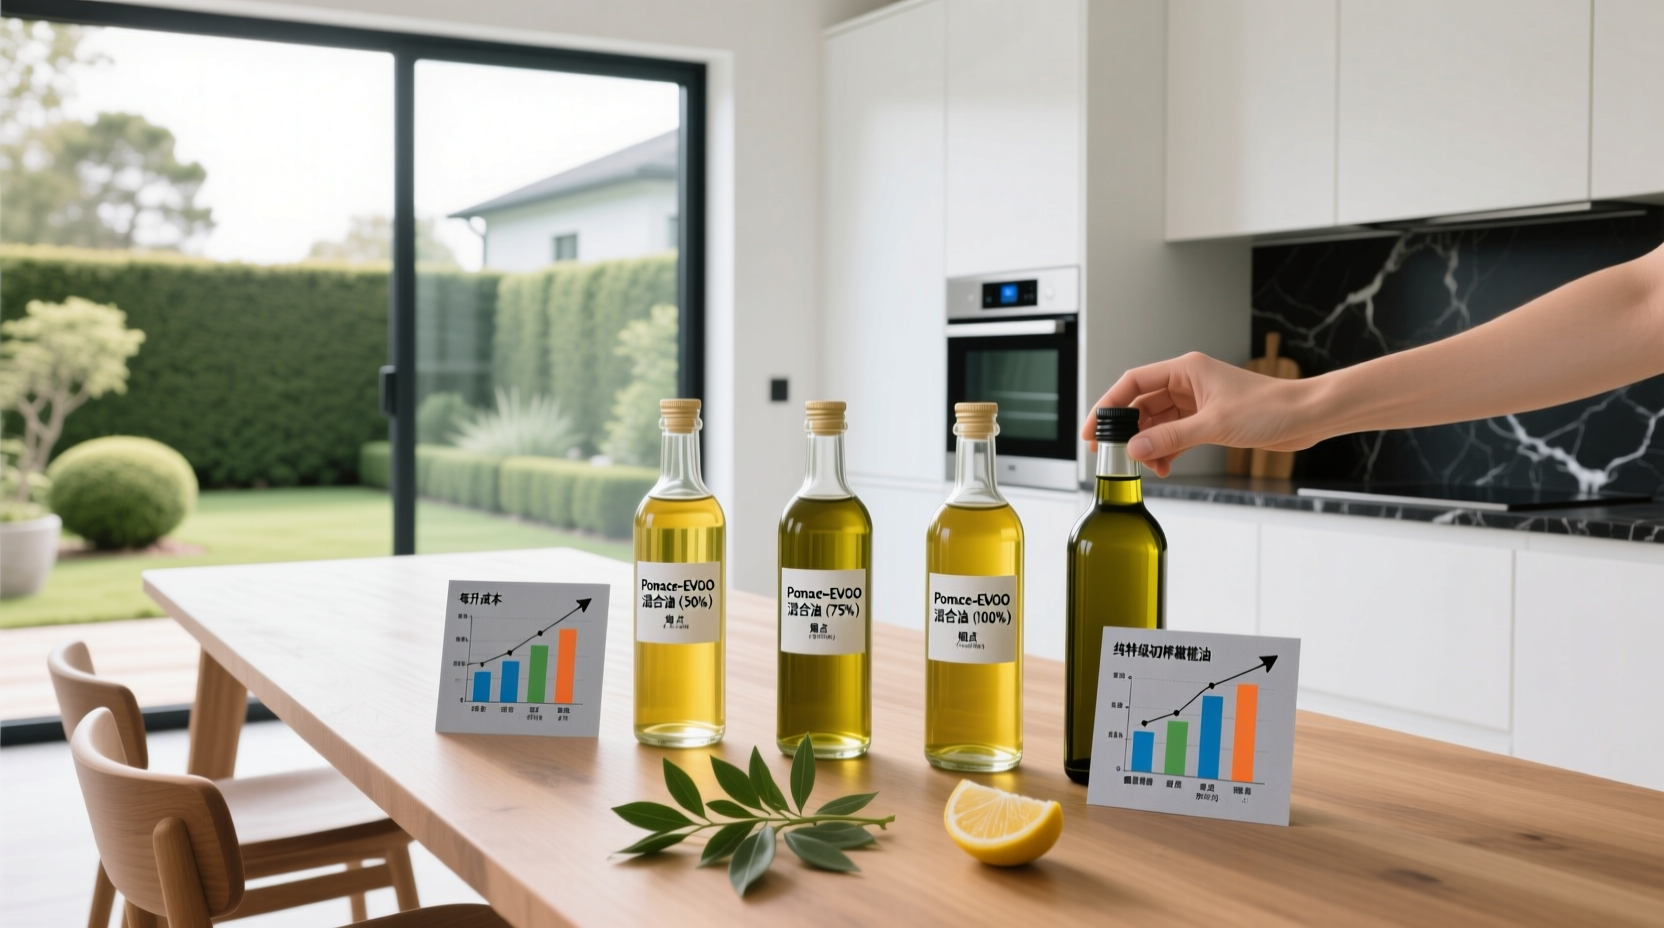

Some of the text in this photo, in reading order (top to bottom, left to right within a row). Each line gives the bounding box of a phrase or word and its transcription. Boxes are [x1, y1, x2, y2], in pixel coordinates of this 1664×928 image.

[678, 593, 713, 611] (50%)
[826, 602, 860, 618] (75%)
[972, 609, 1012, 626] (100%)
